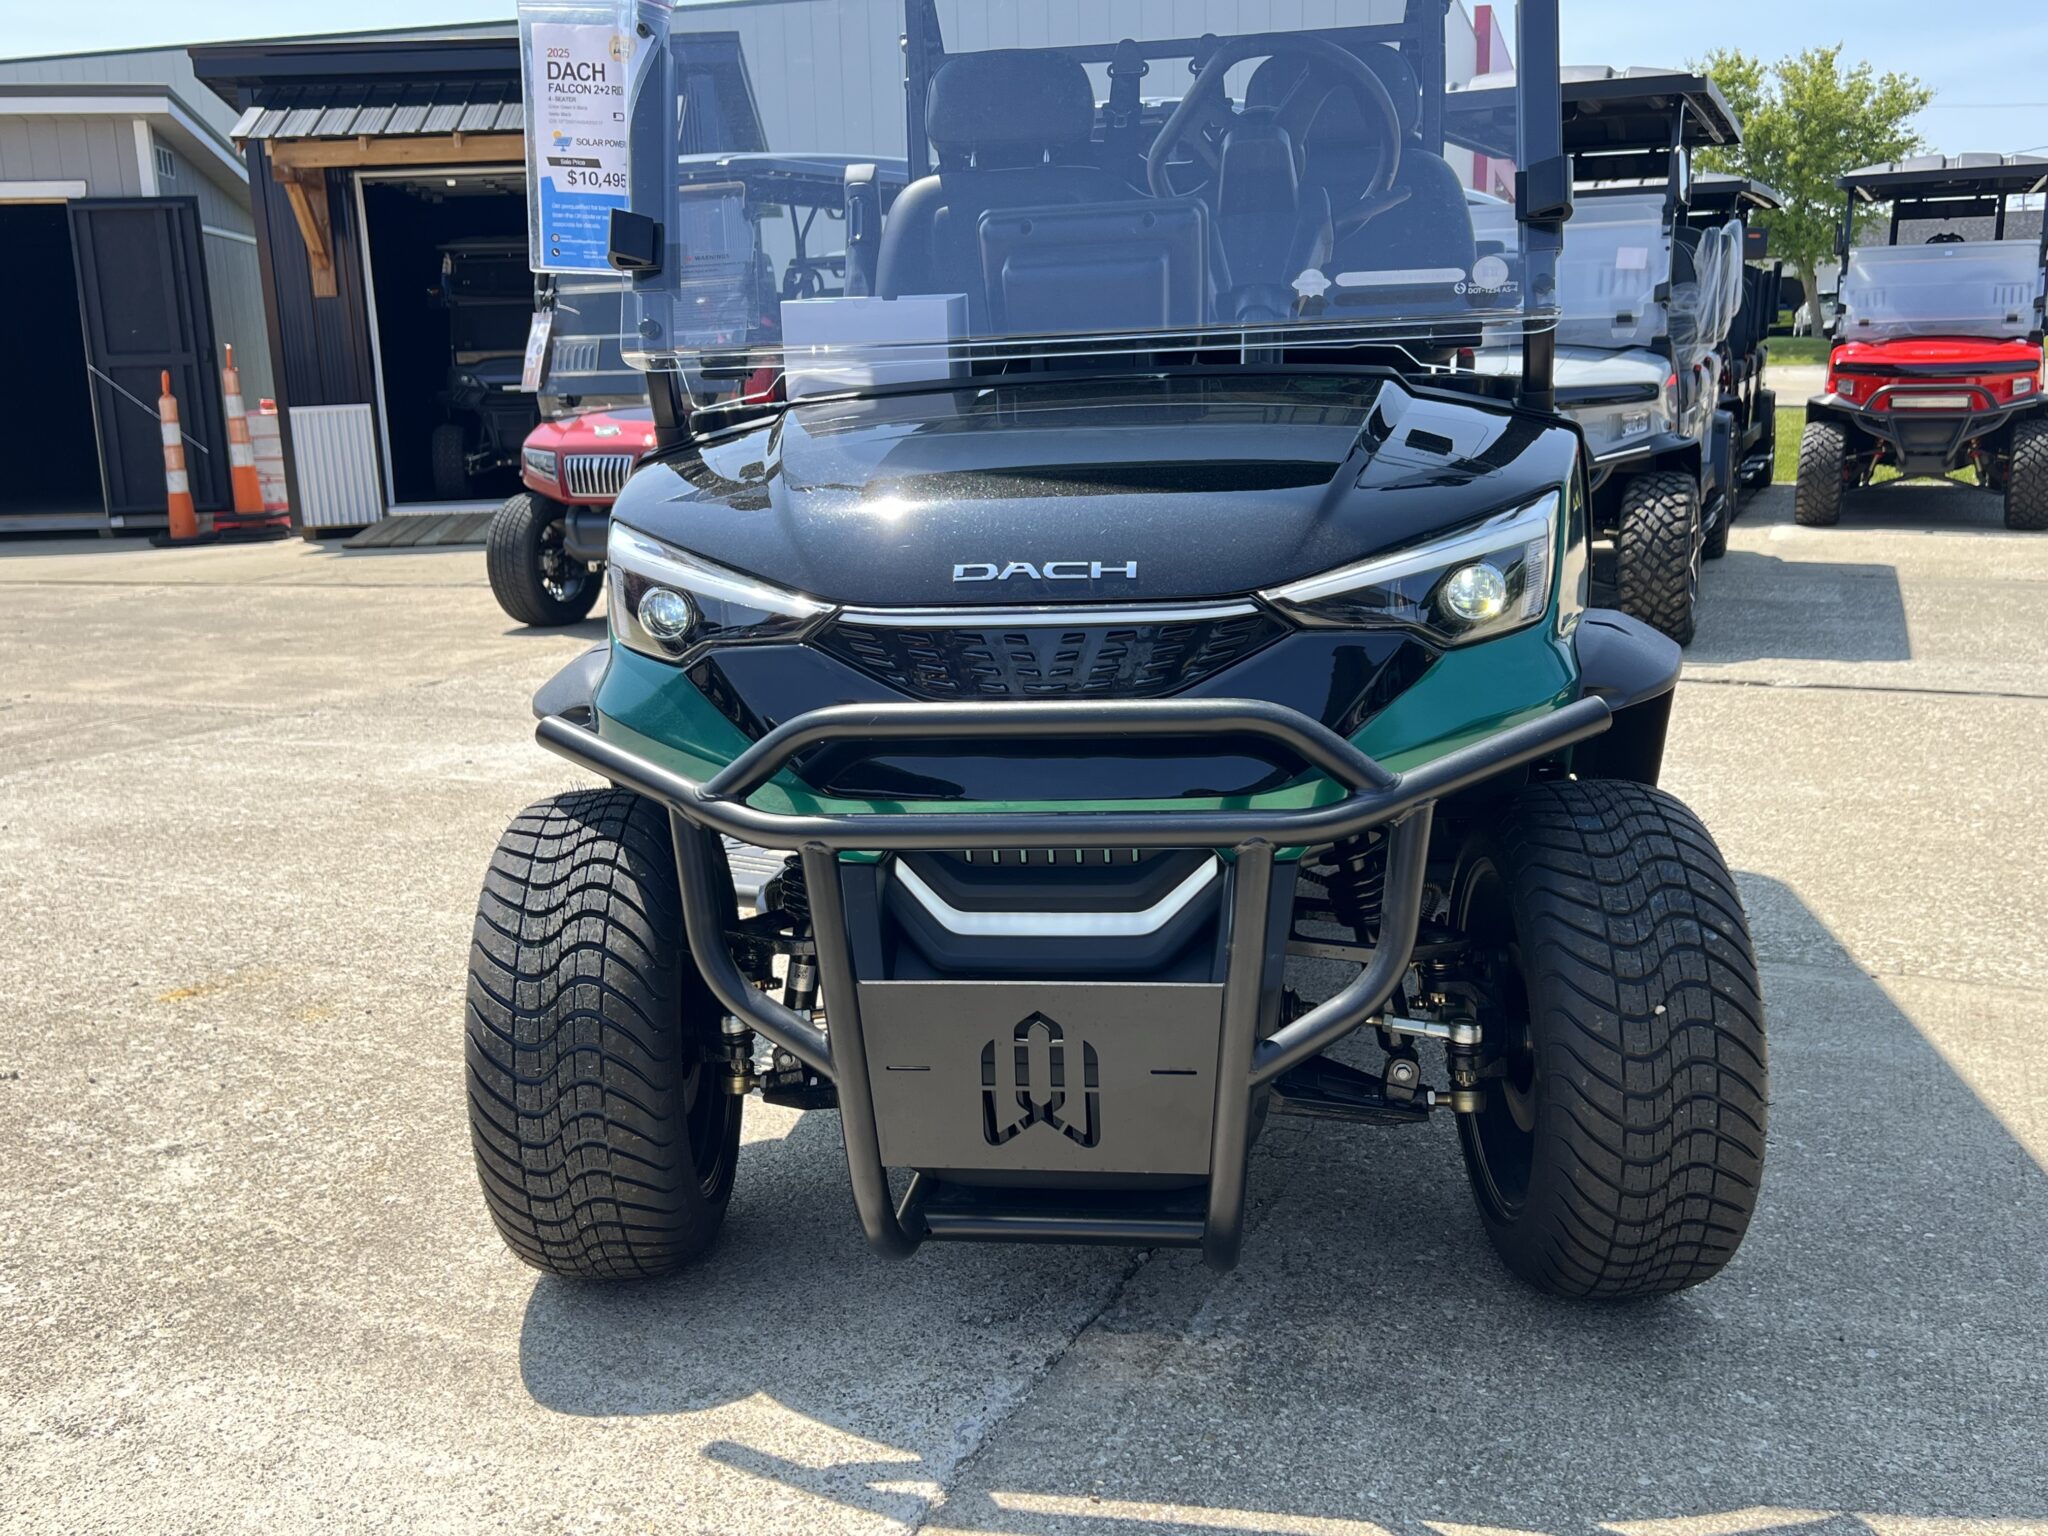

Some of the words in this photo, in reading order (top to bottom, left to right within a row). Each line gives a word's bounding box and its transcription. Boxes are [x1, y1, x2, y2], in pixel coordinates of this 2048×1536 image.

[547, 48, 570, 58] 2025
[547, 61, 606, 82] DACH
[548, 83, 592, 95] FALCON
[593, 85, 610, 96] 2+2
[576, 138, 604, 147] SOLAR
[567, 169, 626, 188] $10,495
[952, 560, 1138, 583] DACH
